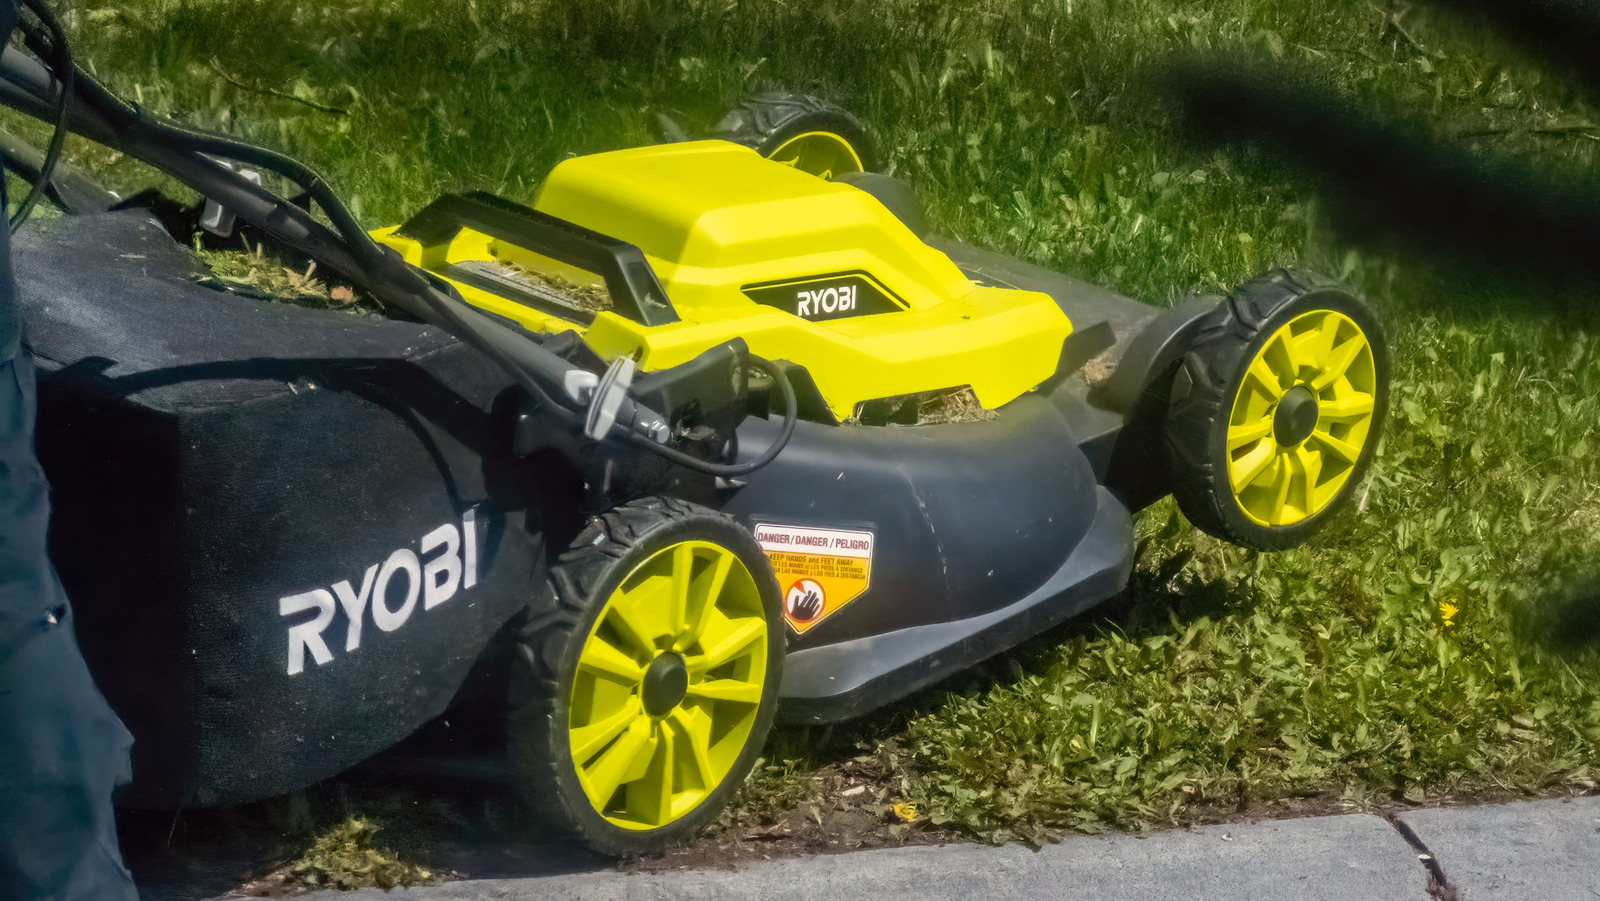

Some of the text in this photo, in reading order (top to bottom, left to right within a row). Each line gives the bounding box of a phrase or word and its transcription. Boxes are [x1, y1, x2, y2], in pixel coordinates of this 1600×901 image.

[797, 284, 857, 317] RYOBI
[757, 532, 790, 544] DANGER
[796, 535, 828, 547] DANGER
[835, 538, 870, 551] PELIGRO
[769, 554, 785, 562] KEEP
[786, 555, 807, 563] HANDS
[820, 557, 835, 565] FEET
[279, 508, 477, 675] RYOBI
